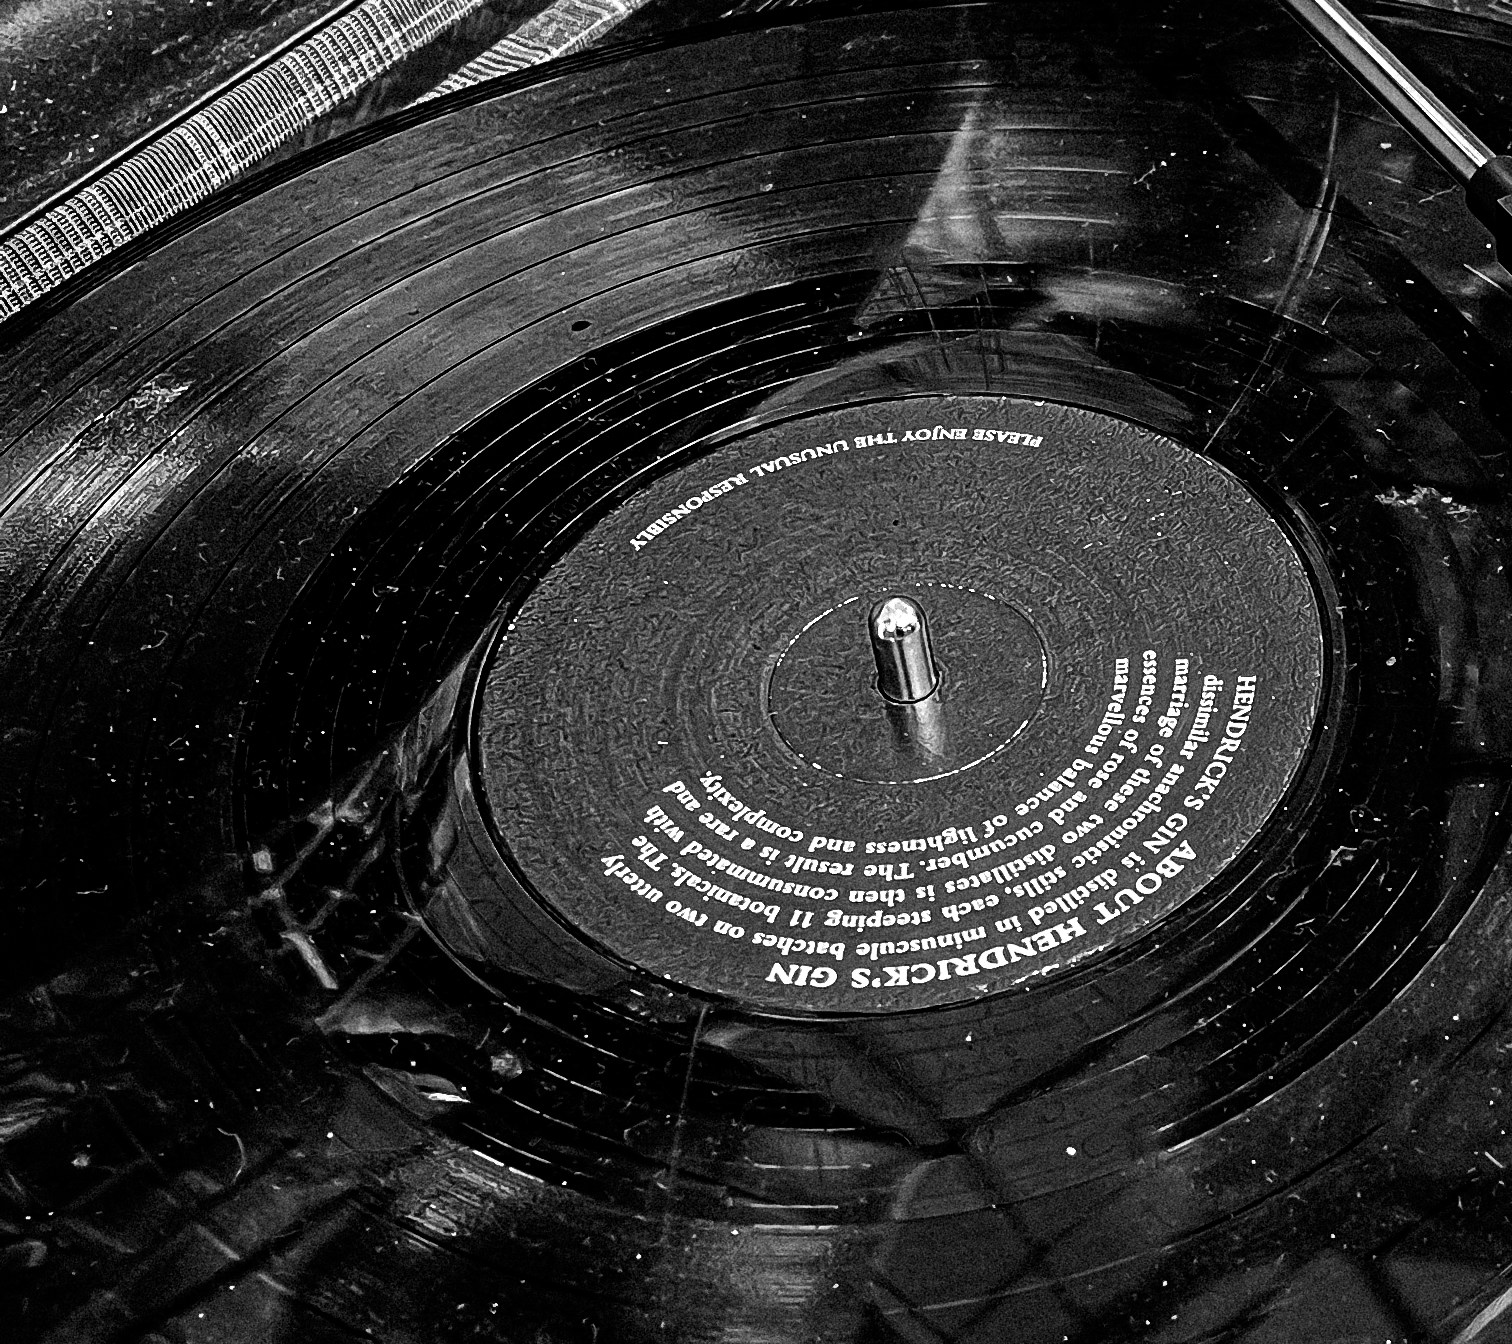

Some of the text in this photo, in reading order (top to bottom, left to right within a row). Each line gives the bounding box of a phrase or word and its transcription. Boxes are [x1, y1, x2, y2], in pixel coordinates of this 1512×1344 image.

[630, 426, 1043, 551] PLEASE ENJOY THE UNUSUAL RESPONSIBLY
[662, 650, 1156, 881] essences of rose and cucumber. The result is a rare and
[700, 658, 1128, 854] marvellous balance of lightness and complexity.
[1180, 674, 1223, 760] dissimilar
[601, 675, 1256, 960] HENDRICK'S GIN is distilled in minuscule batches on two utterly
[644, 658, 1190, 907] marriage of these two distillates is then consummated with
[1072, 764, 1184, 868] anachronistic
[632, 835, 668, 872] The
[670, 862, 780, 923] botanicals.
[765, 840, 1196, 988] ABOUT HENDRICK'S GIN
[790, 910, 814, 928] 11
[824, 910, 931, 932] steeping
[942, 894, 1000, 922] each
